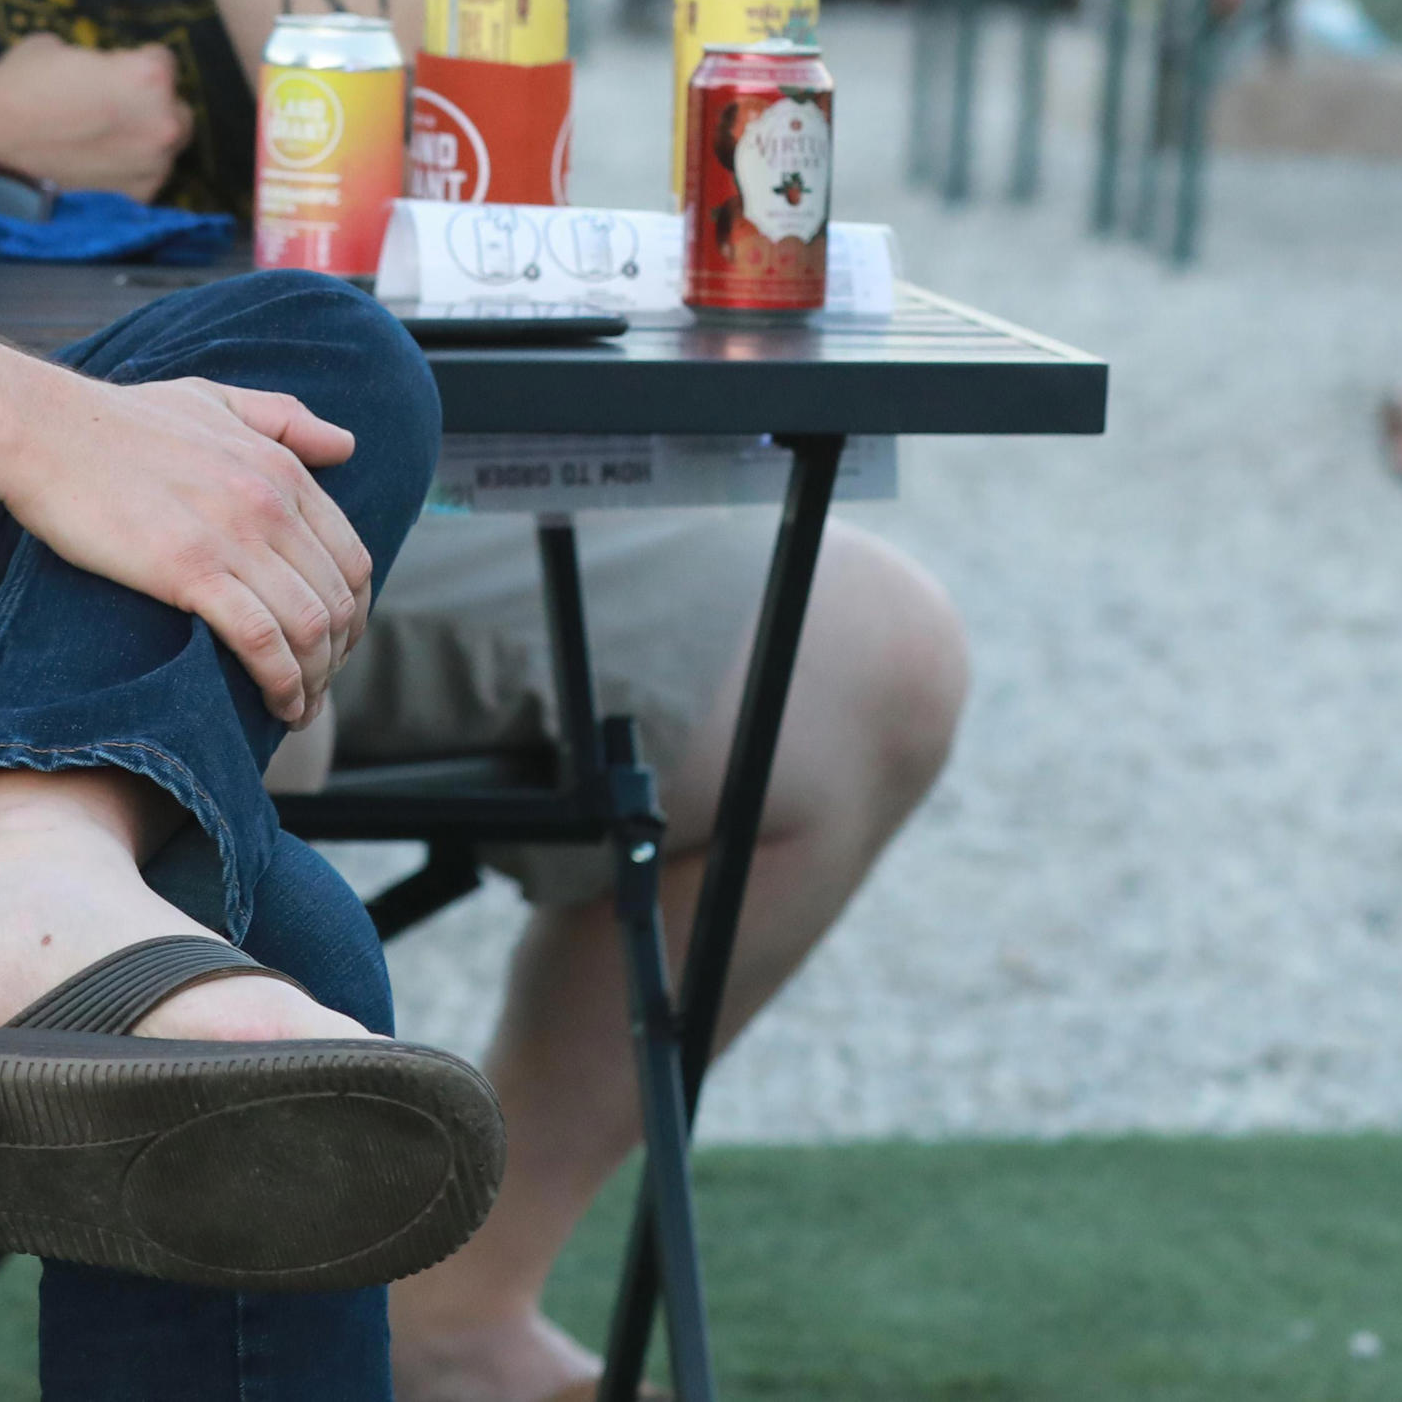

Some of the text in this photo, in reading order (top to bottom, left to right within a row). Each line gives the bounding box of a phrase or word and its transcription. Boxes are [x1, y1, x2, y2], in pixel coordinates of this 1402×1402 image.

[409, 130, 459, 168] AND
[475, 460, 653, 490] HOW TO ORDER
